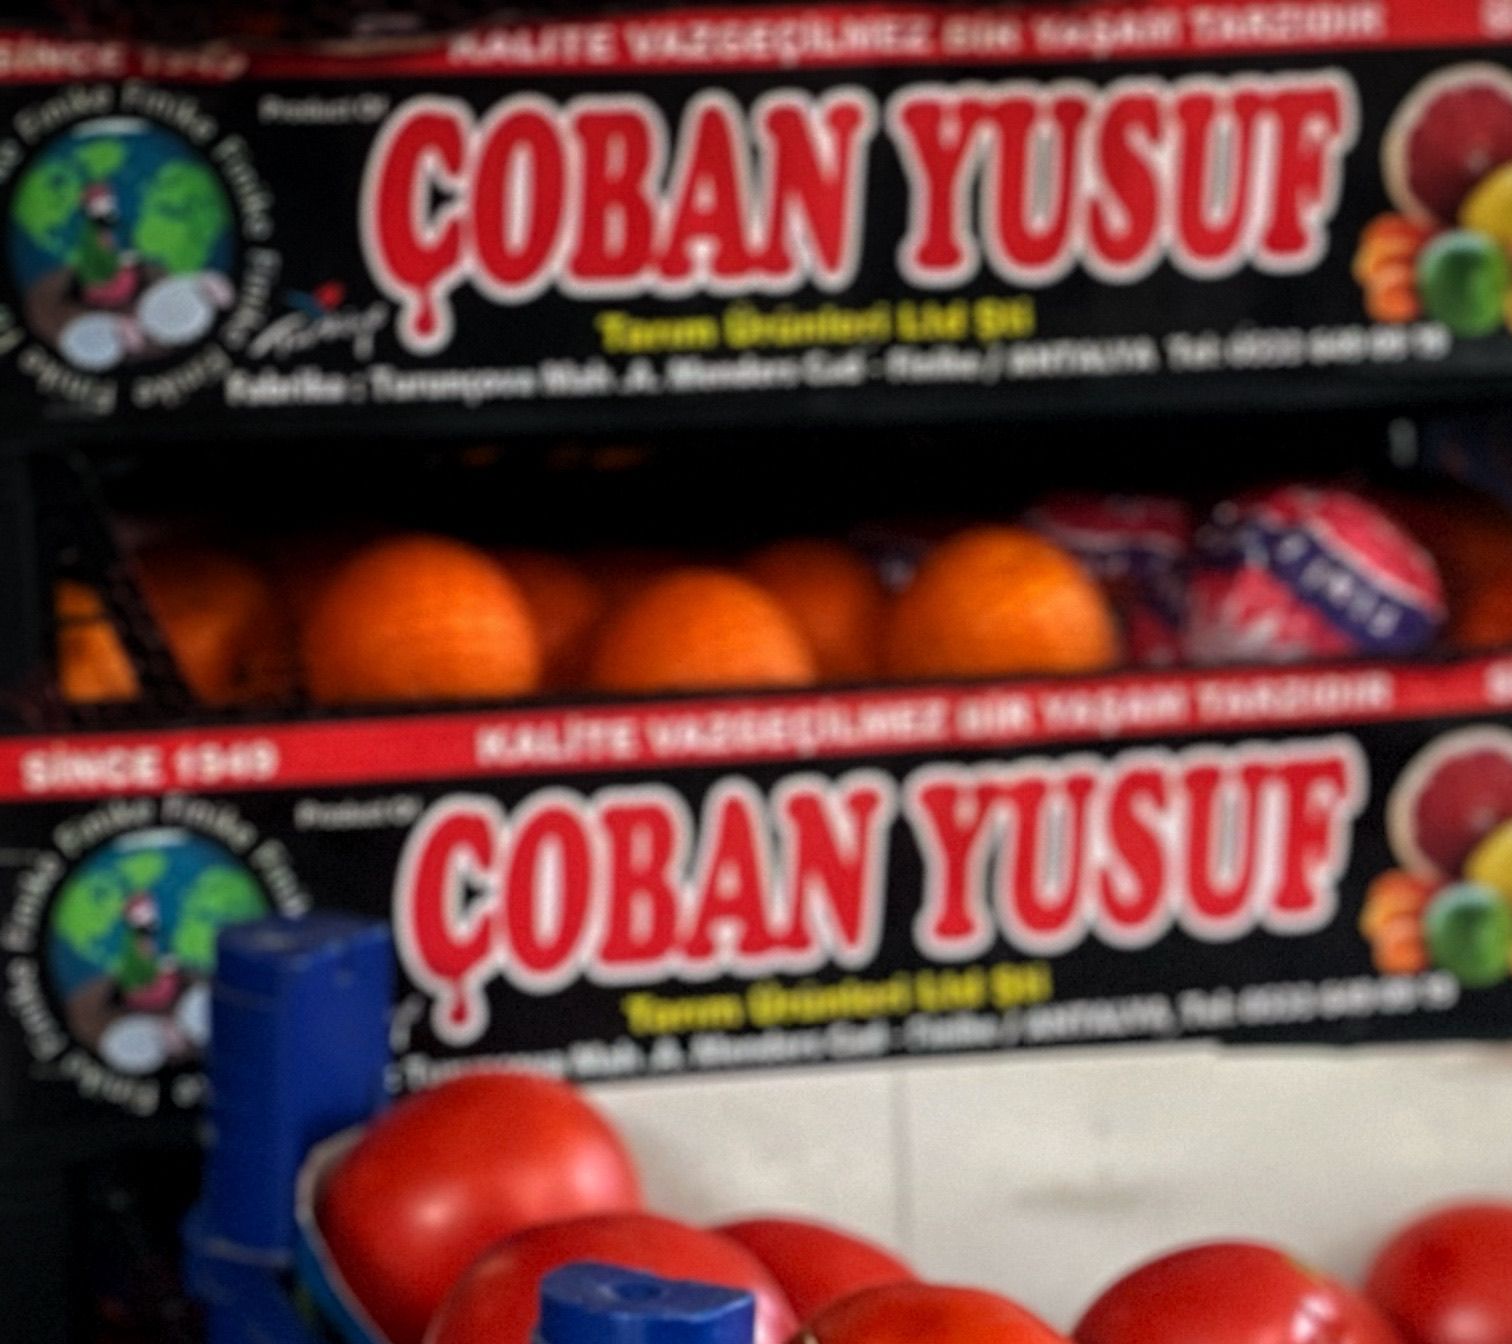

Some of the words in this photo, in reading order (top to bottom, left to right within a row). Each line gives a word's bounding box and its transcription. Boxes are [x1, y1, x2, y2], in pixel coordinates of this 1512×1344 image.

[360, 84, 876, 355] ÇOBAN
[884, 65, 1360, 290] YUSUF
[894, 299, 968, 342] Ltd
[1005, 335, 1162, 380] ANTALYA
[173, 737, 280, 785] 1949
[392, 768, 897, 1046] ÇOBAN
[903, 734, 1370, 962] YUSUF
[914, 966, 988, 1014] Ltd
[1025, 993, 1174, 1038] ANTALYA
